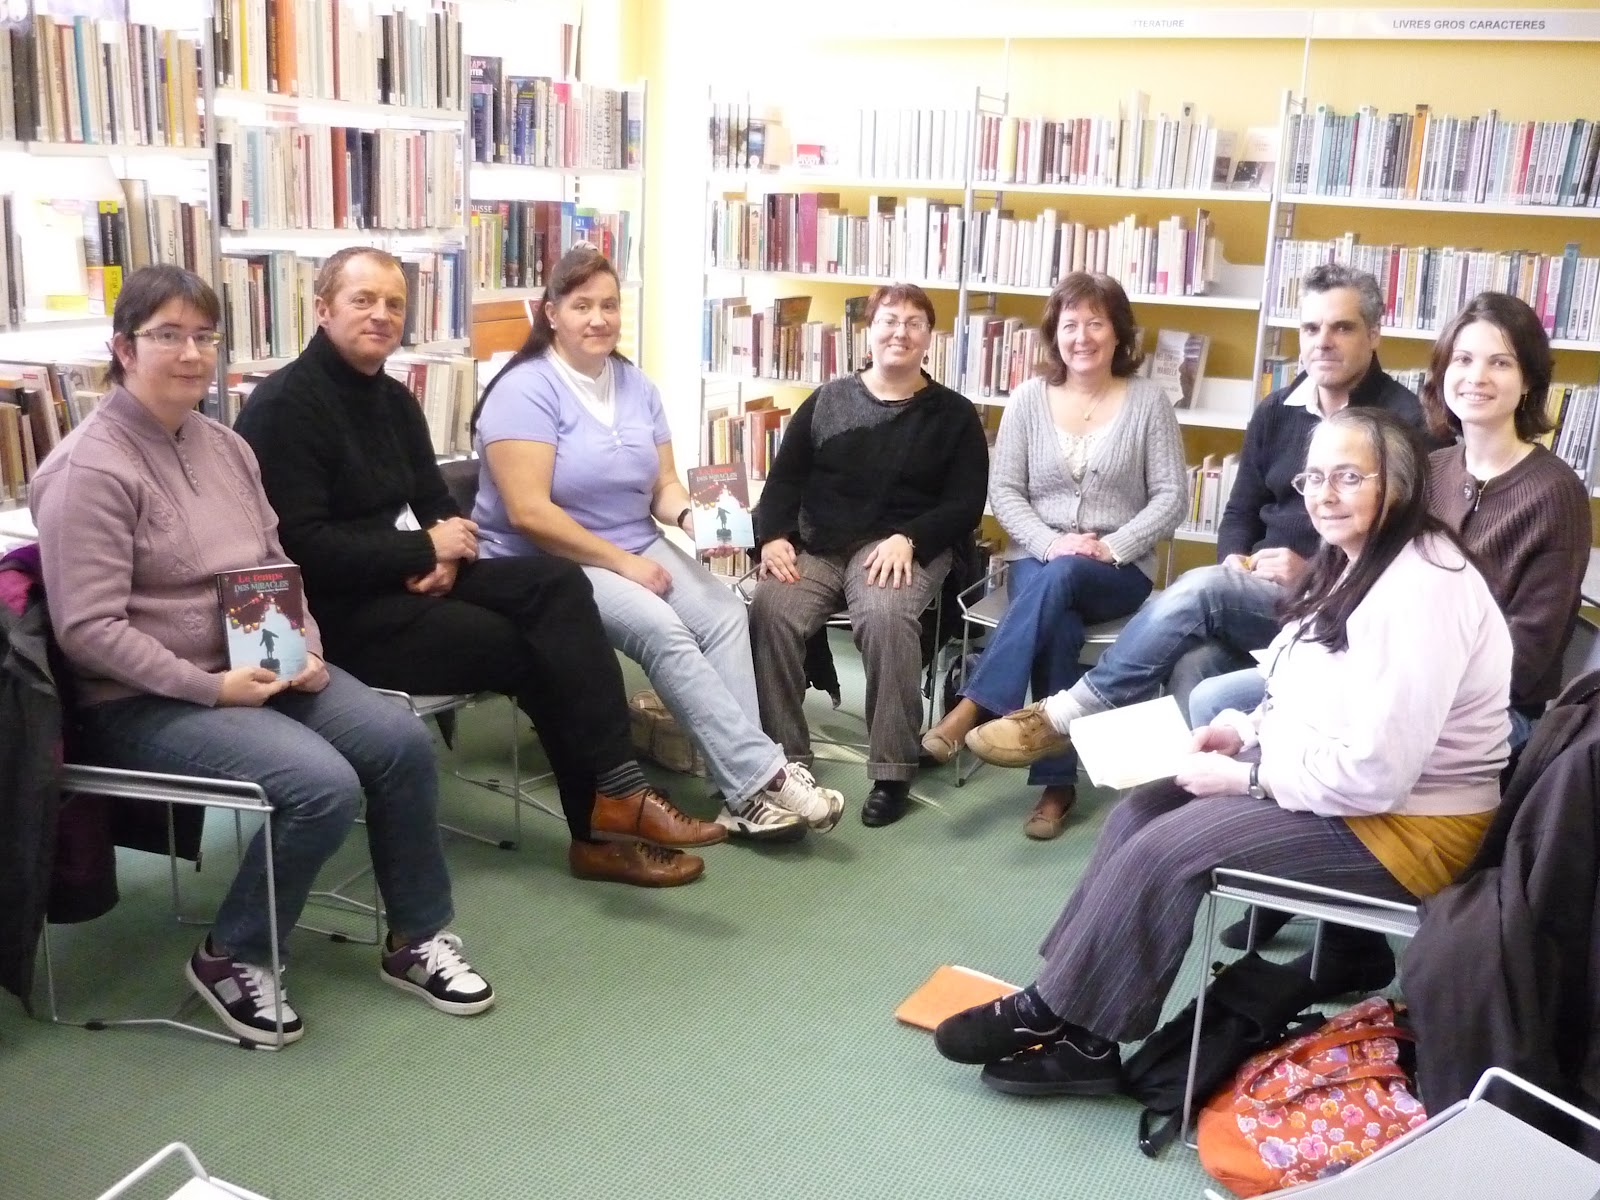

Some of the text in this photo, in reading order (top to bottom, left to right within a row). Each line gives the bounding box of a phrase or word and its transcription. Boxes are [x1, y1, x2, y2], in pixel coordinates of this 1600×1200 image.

[1132, 19, 1185, 28] TTERATURE
[1393, 20, 1546, 30] LIVRES GROS CARACTERES
[237, 575, 250, 584] Le
[234, 583, 250, 593] DES
[251, 580, 289, 591] MIRACLES
